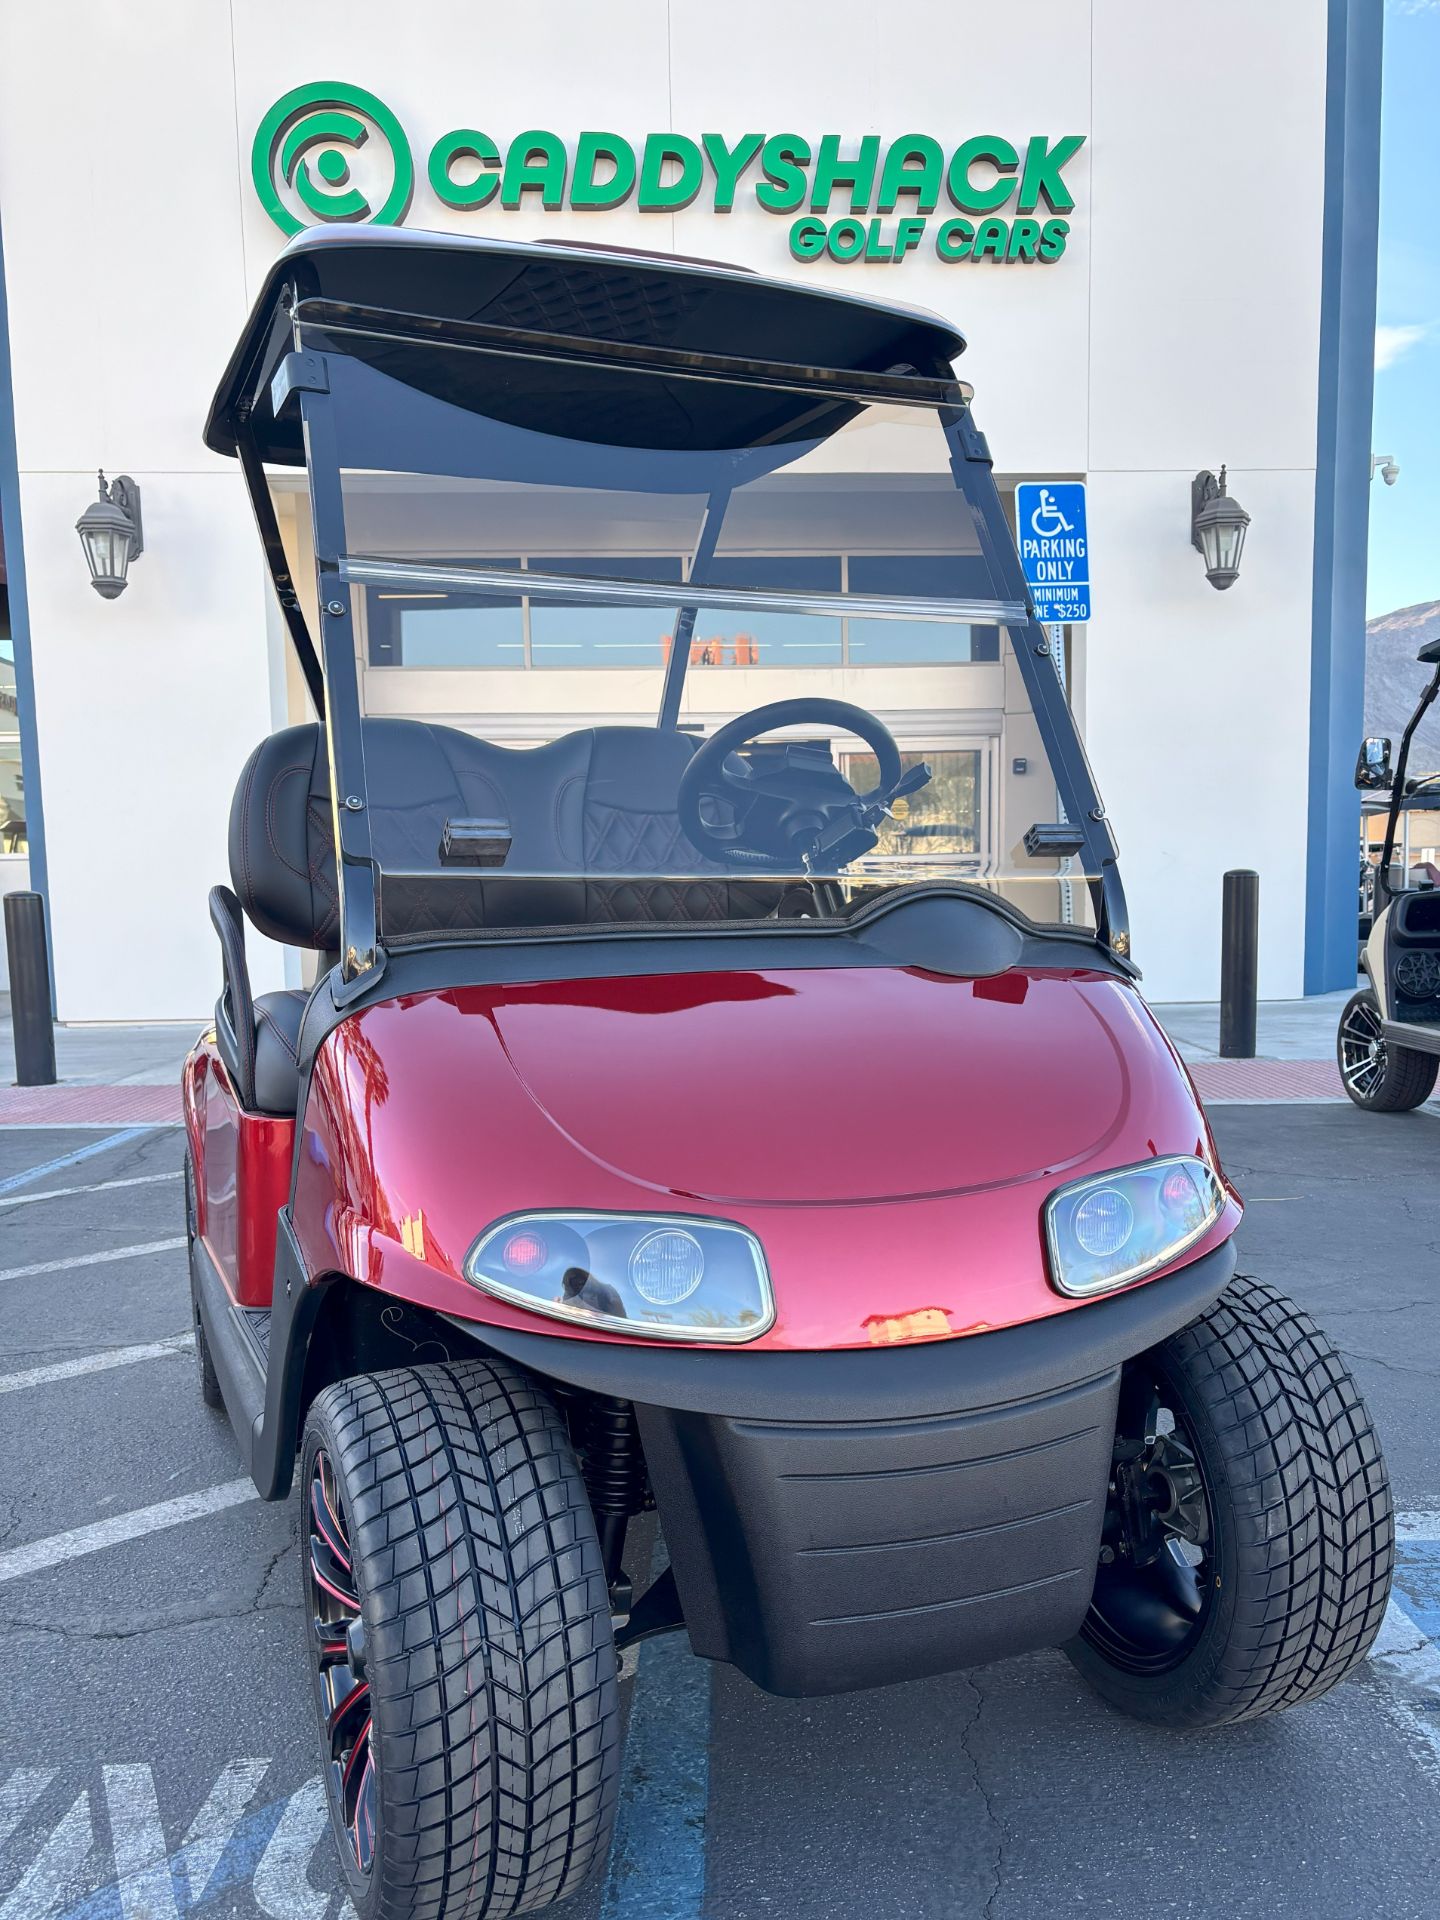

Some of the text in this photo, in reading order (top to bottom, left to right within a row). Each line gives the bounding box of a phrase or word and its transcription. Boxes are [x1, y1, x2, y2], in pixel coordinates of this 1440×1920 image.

[428, 129, 1087, 214] CADDYSHACK
[789, 217, 1070, 264] GOLF CARS
[1023, 538, 1086, 559] PARKING
[1036, 561, 1074, 581] ONLY
[1034, 588, 1079, 602] MINIMUM
[1034, 603, 1087, 619] NE $250
